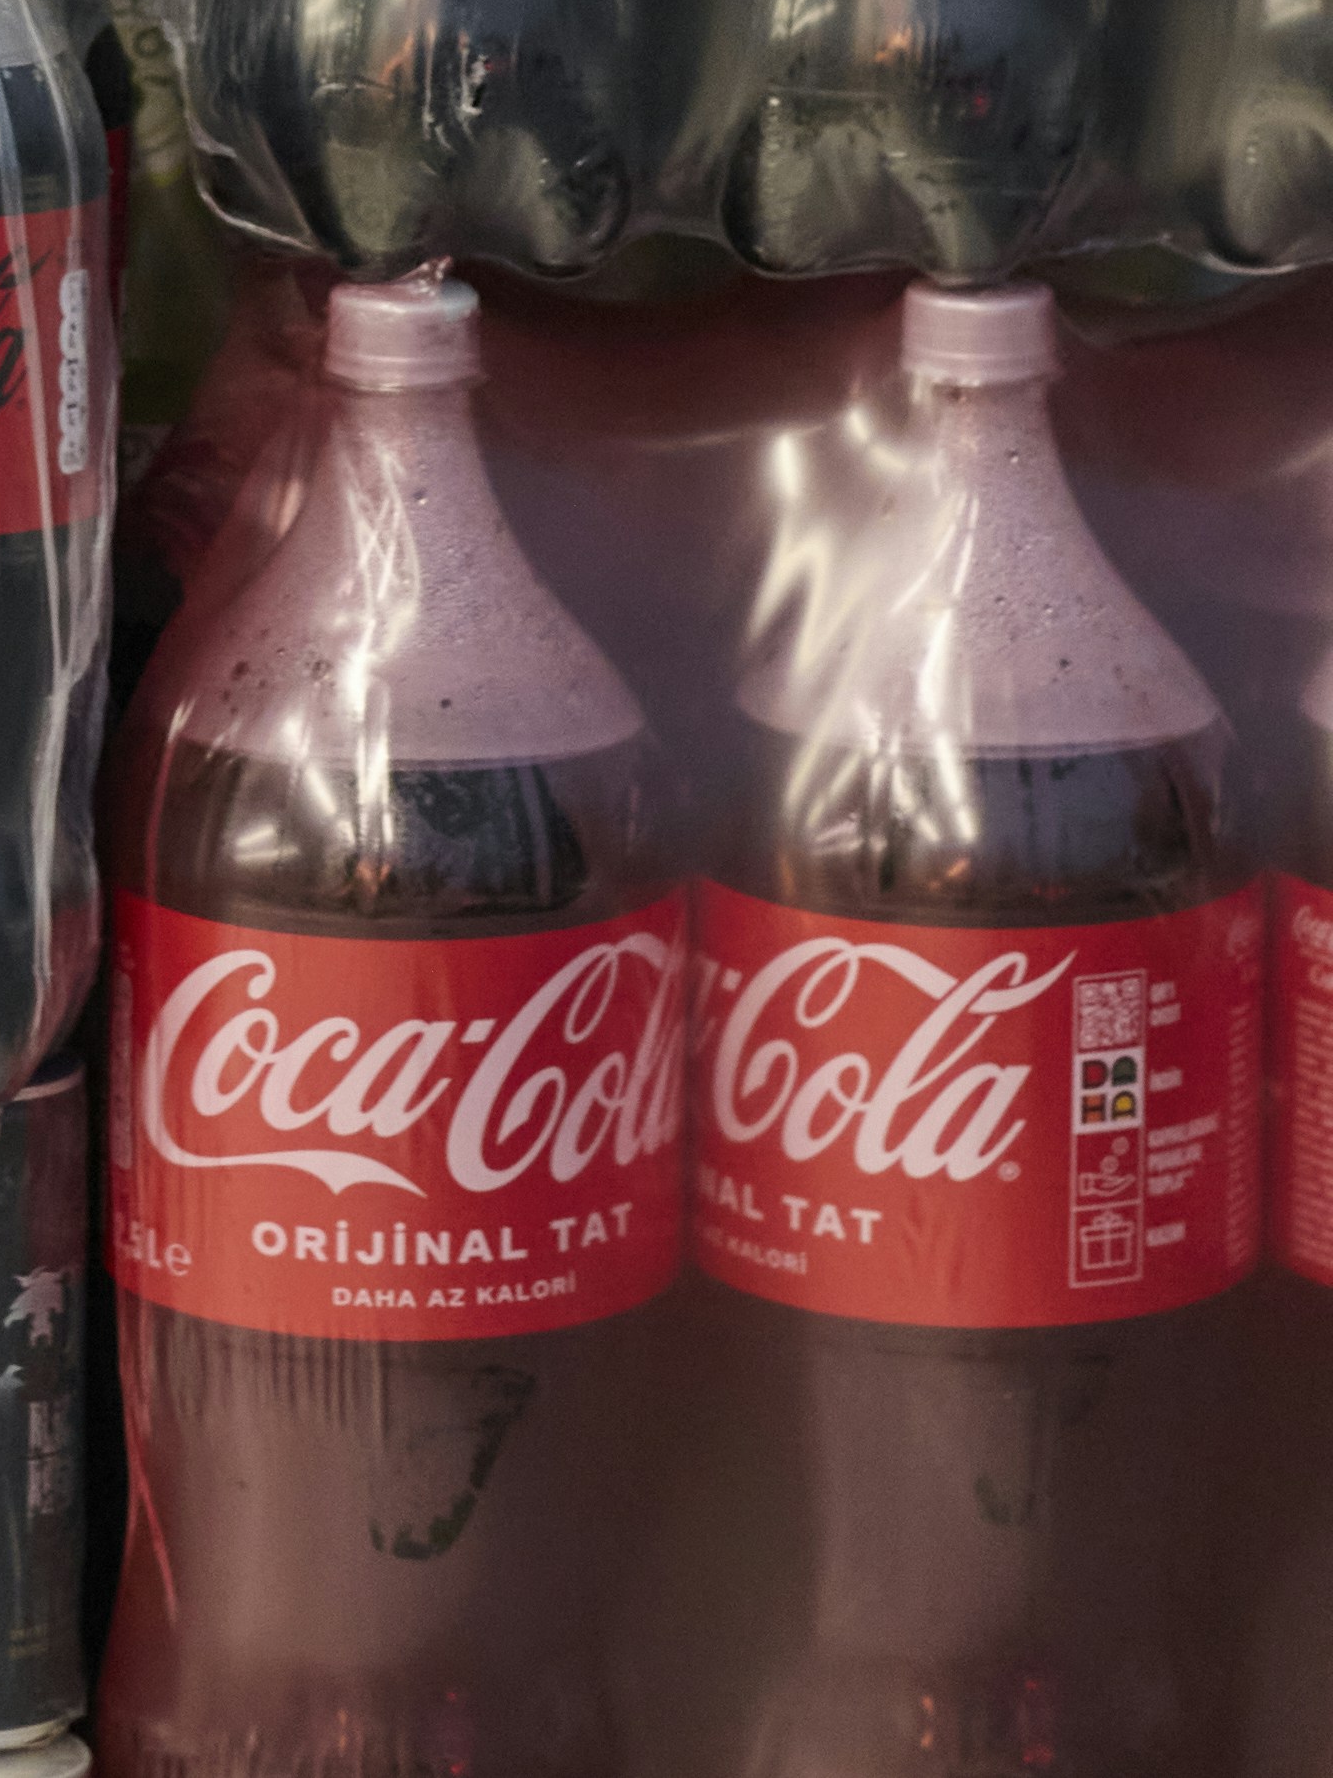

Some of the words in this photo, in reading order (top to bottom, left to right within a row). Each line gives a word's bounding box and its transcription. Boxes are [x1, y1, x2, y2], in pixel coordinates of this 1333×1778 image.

[250, 1219, 529, 1267] ORİJİNAL
[548, 1201, 634, 1254] TAT
[780, 1194, 883, 1245] TAT
[332, 1284, 417, 1310] DAHA
[426, 1284, 466, 1308] AZ
[475, 1268, 577, 1307] KALORİ
